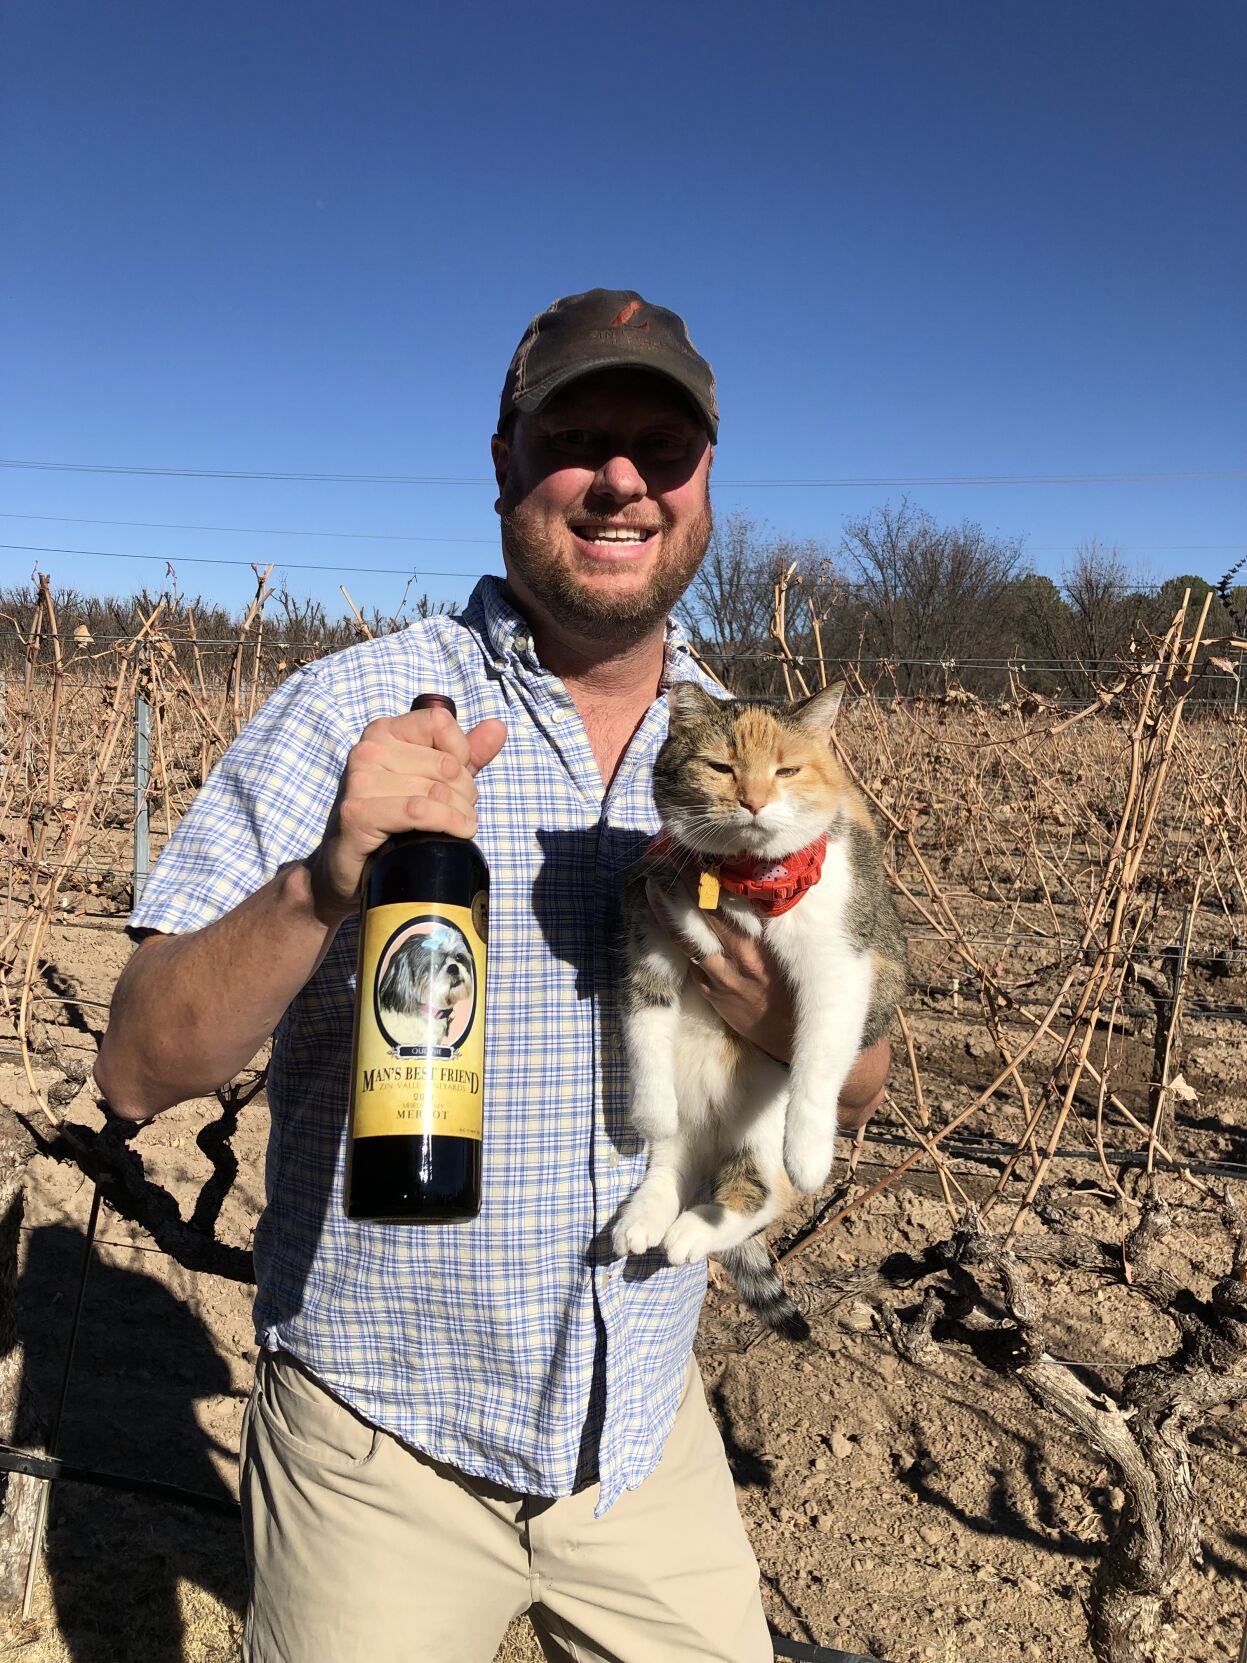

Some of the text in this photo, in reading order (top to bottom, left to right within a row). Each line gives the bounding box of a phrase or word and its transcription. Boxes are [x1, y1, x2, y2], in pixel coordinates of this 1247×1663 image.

[361, 1067, 401, 1093] MAN'S
[440, 1067, 479, 1095] FRIEND
[396, 1110, 449, 1120] MEROT
